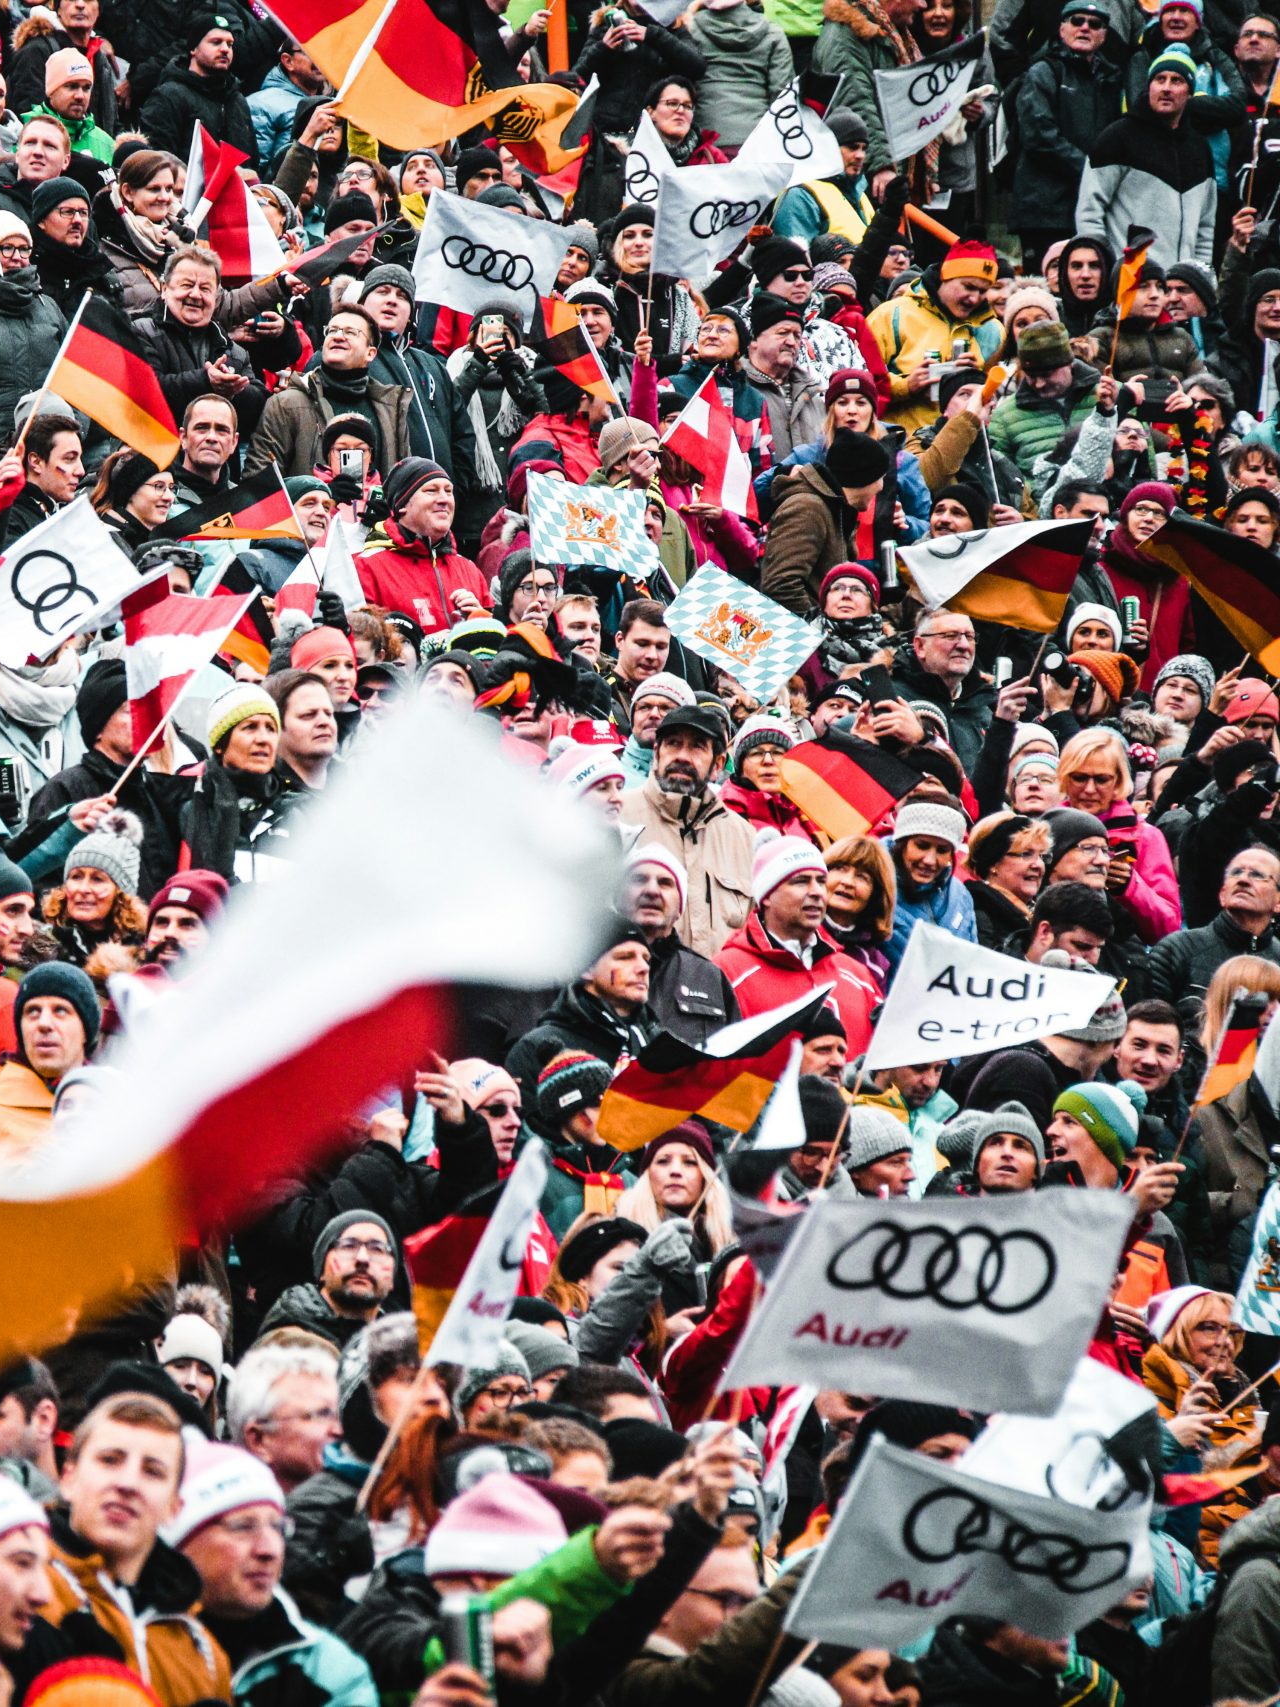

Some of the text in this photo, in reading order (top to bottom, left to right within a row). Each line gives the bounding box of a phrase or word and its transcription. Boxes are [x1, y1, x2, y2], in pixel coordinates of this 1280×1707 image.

[918, 100, 951, 130] Audi
[1, 767, 10, 794] ELTINS
[576, 764, 596, 783] BWT
[927, 964, 1047, 1002] Audi
[794, 1311, 910, 1350] Audi
